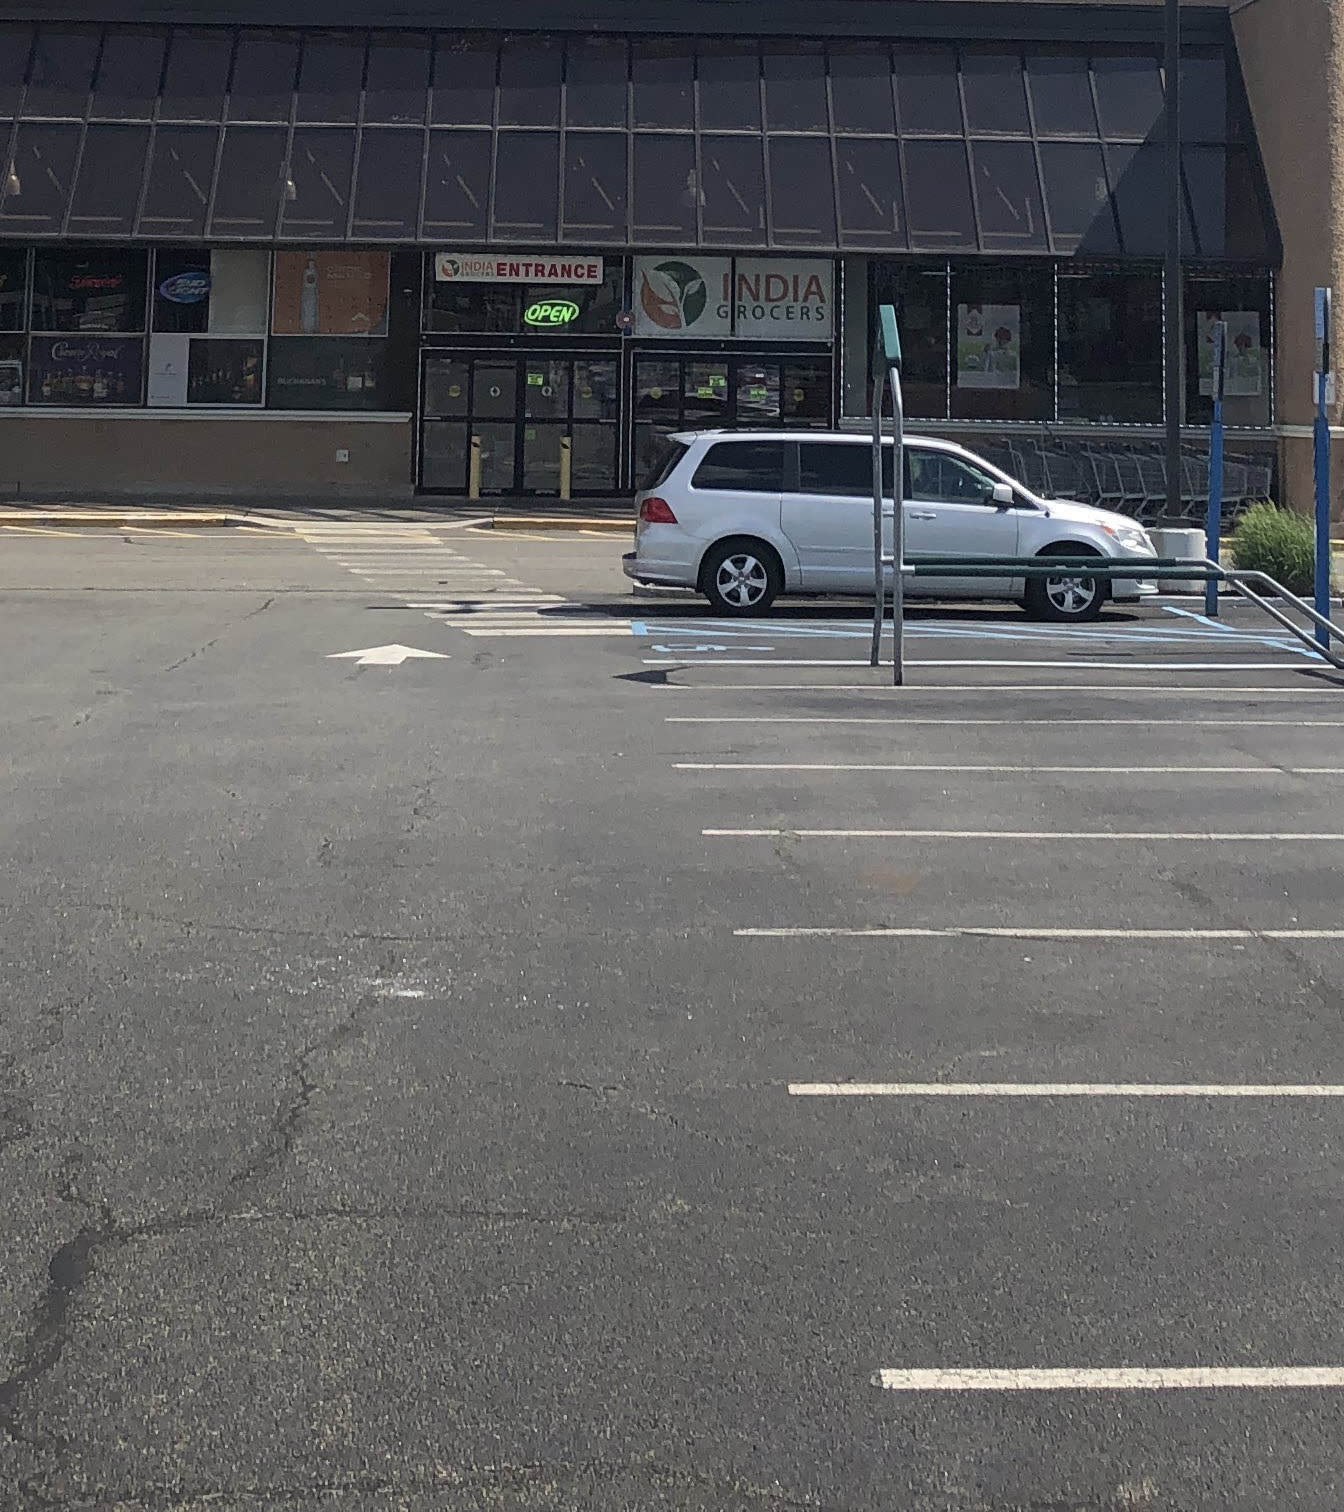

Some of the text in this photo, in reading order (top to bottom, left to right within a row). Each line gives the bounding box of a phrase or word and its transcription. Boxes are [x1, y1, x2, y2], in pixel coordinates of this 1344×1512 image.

[461, 260, 598, 279] INDIA ENTRANCE
[722, 272, 827, 304] INDIA
[527, 304, 574, 323] OPEN
[716, 304, 826, 322] GROCERS
